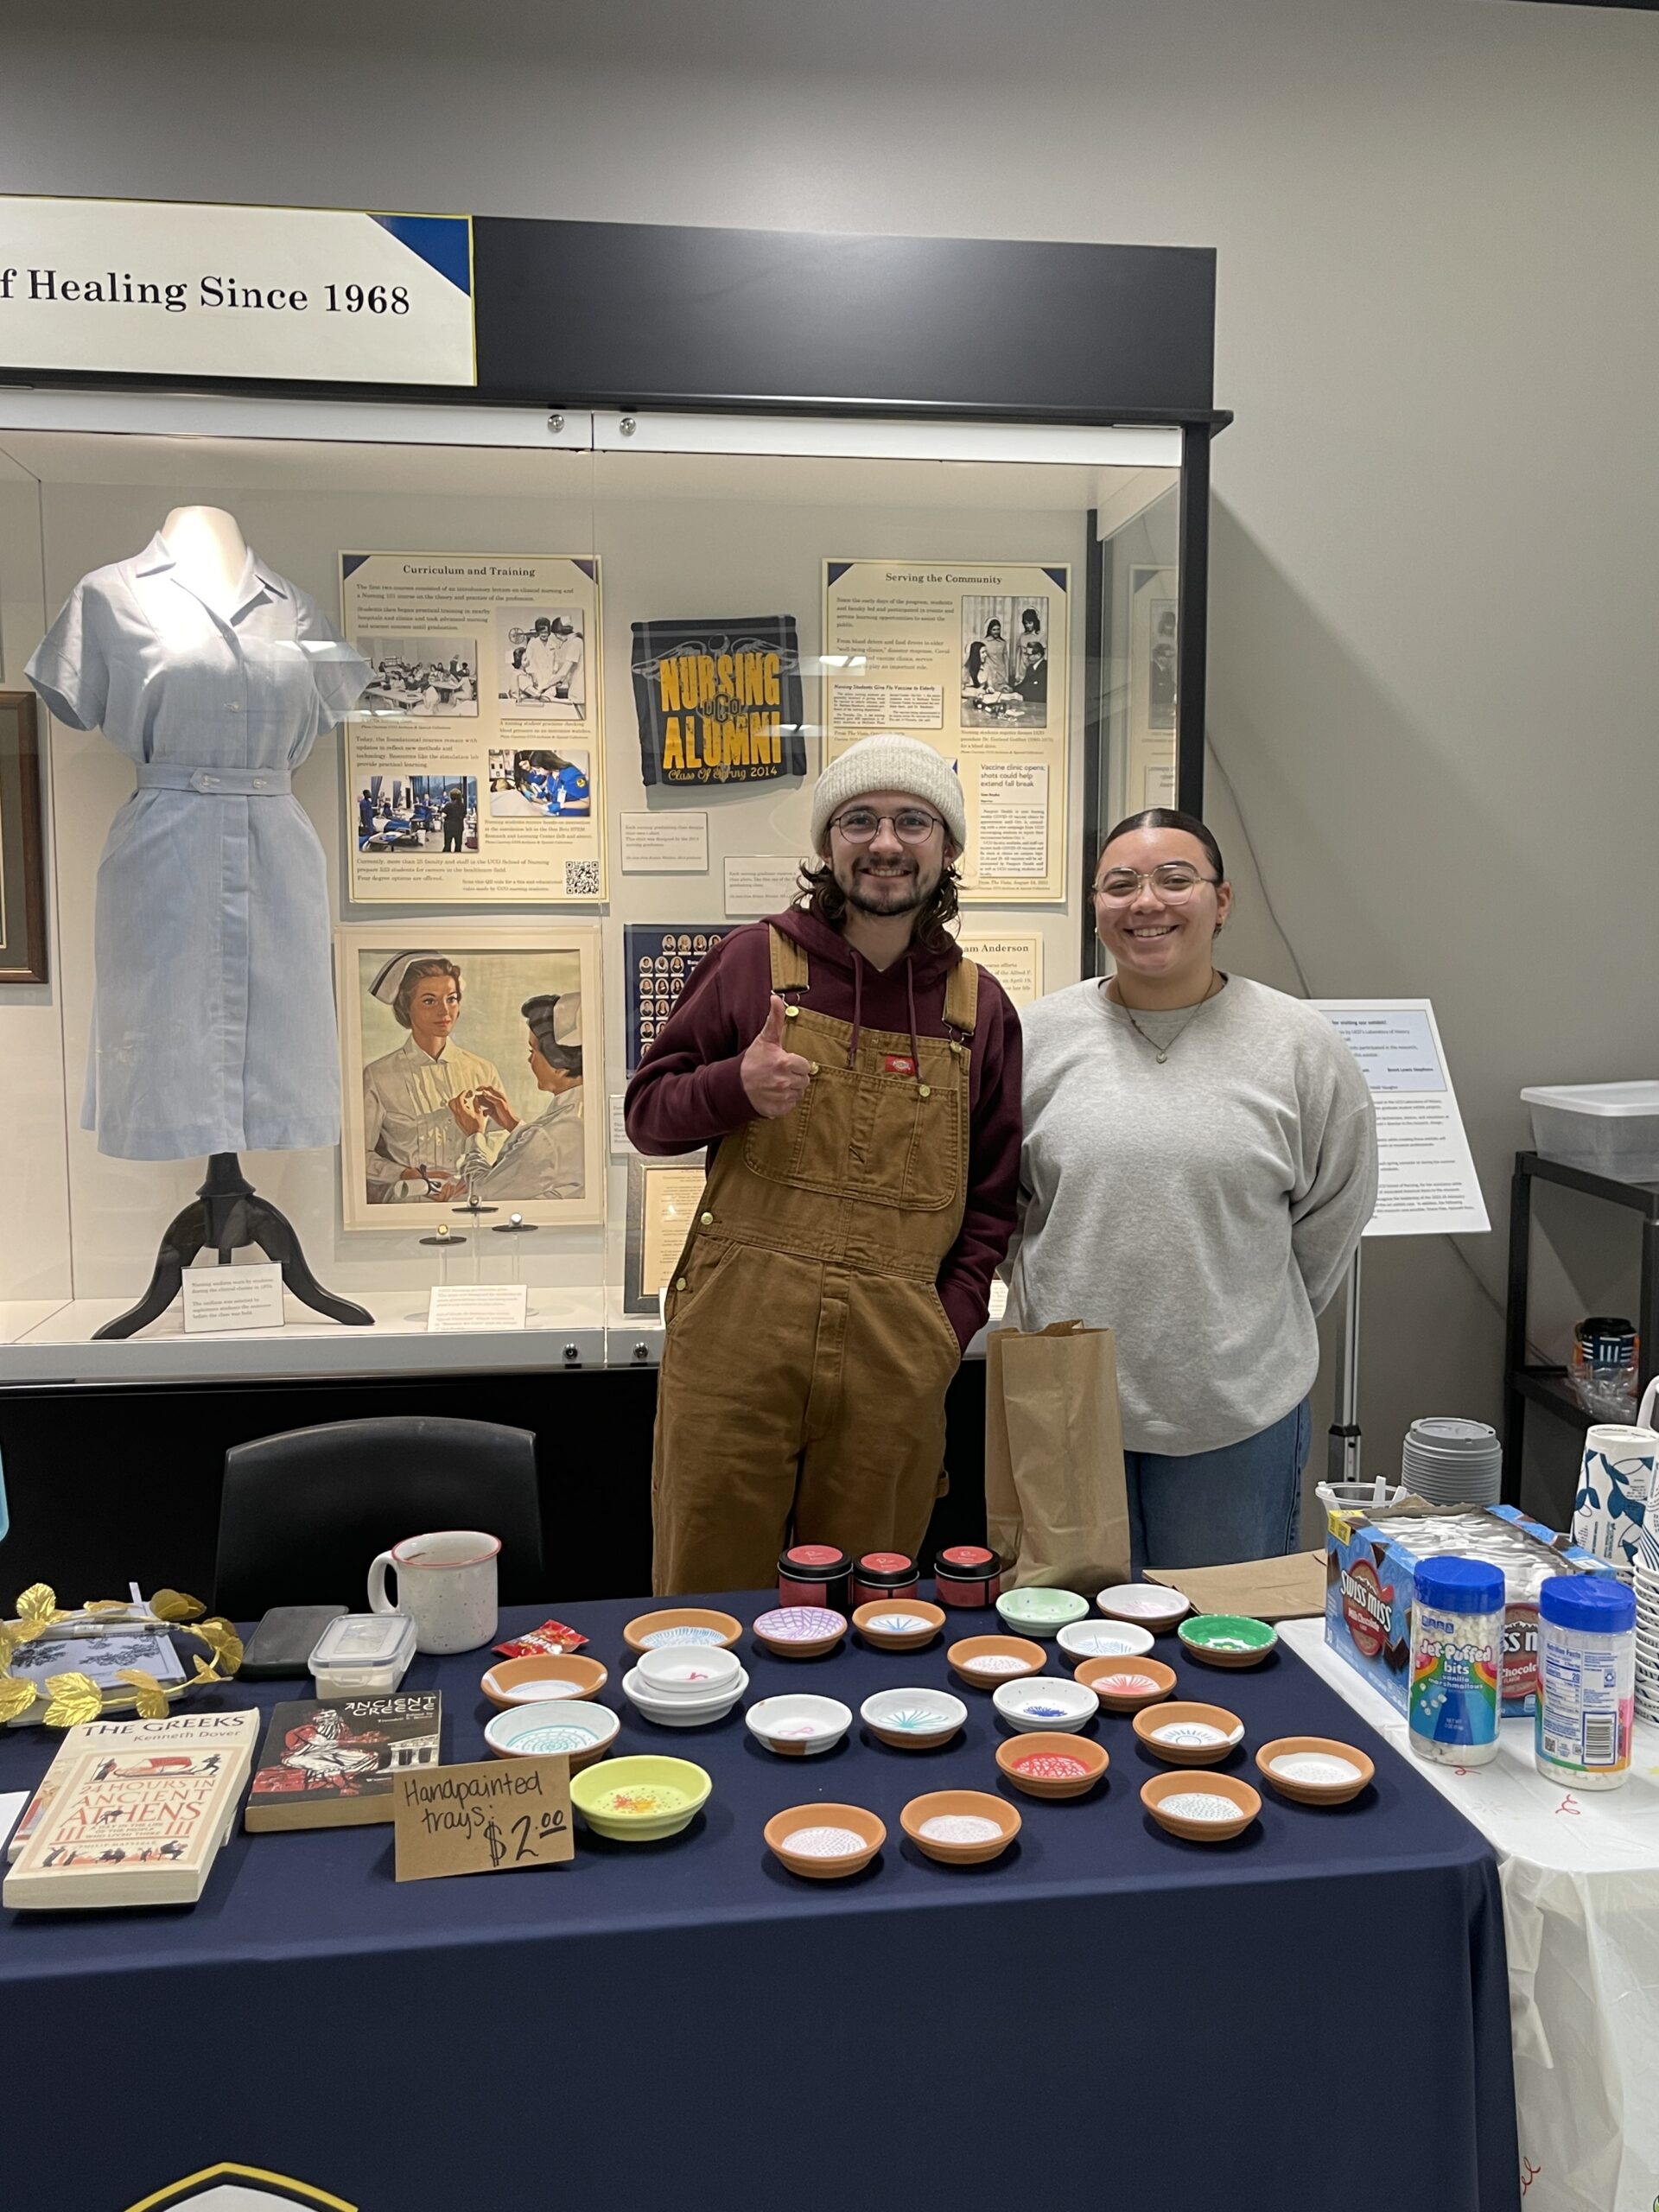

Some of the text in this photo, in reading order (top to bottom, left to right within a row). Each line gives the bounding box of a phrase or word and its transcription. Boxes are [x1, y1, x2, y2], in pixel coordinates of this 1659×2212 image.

[27, 269, 188, 312] Healing
[200, 275, 308, 312] Since
[323, 283, 410, 315] 1968
[403, 565, 535, 578] Curriculum and Training
[886, 573, 1001, 586] Serving the Community
[659, 652, 780, 712] NURSING
[663, 711, 782, 769] ALUMNI
[750, 766, 778, 777] 2014
[1421, 1639, 1491, 1663] Jet-Puffed
[1444, 1661, 1469, 1674] bits
[345, 1696, 436, 1710] ANCIENT
[353, 1702, 435, 1716] GREECE
[83, 1716, 245, 1737] THE GREEKS
[133, 1732, 194, 1742] Kenneth
[79, 1779, 216, 1795] 24 HOURS IN
[404, 1770, 543, 1810] Handpainted
[70, 1789, 213, 1808] ANCIENT
[59, 1802, 205, 1828] ATHENS
